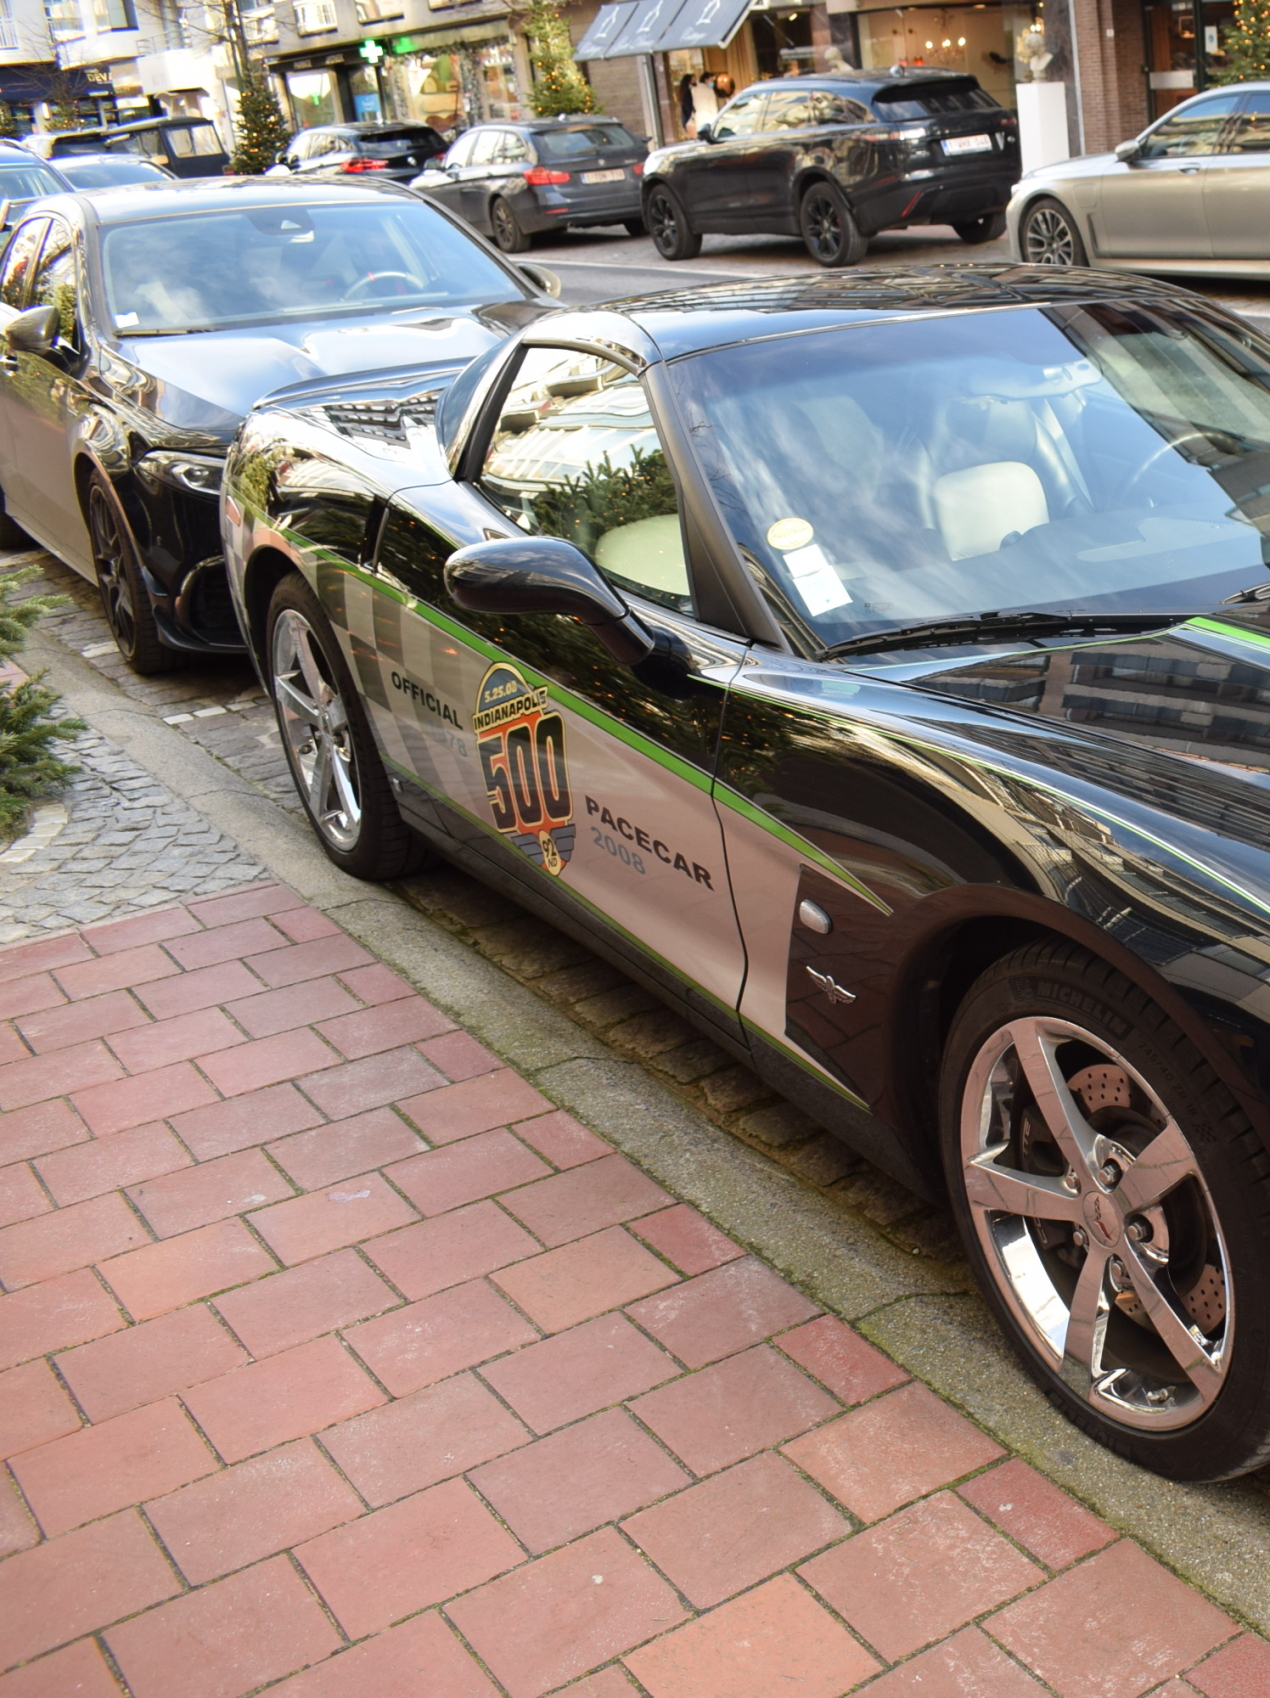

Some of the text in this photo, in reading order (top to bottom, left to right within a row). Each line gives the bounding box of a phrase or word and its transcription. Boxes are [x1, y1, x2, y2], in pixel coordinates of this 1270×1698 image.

[391, 671, 463, 731] OFFICIAL
[473, 687, 548, 733] INDIANAPOLIS
[484, 680, 518, 703] 5.25.08
[477, 711, 573, 833] 500
[542, 838, 557, 859] 92
[585, 795, 715, 892] PACECAR
[590, 826, 646, 875] 2008
[1036, 980, 1129, 1035] MICHELIN
